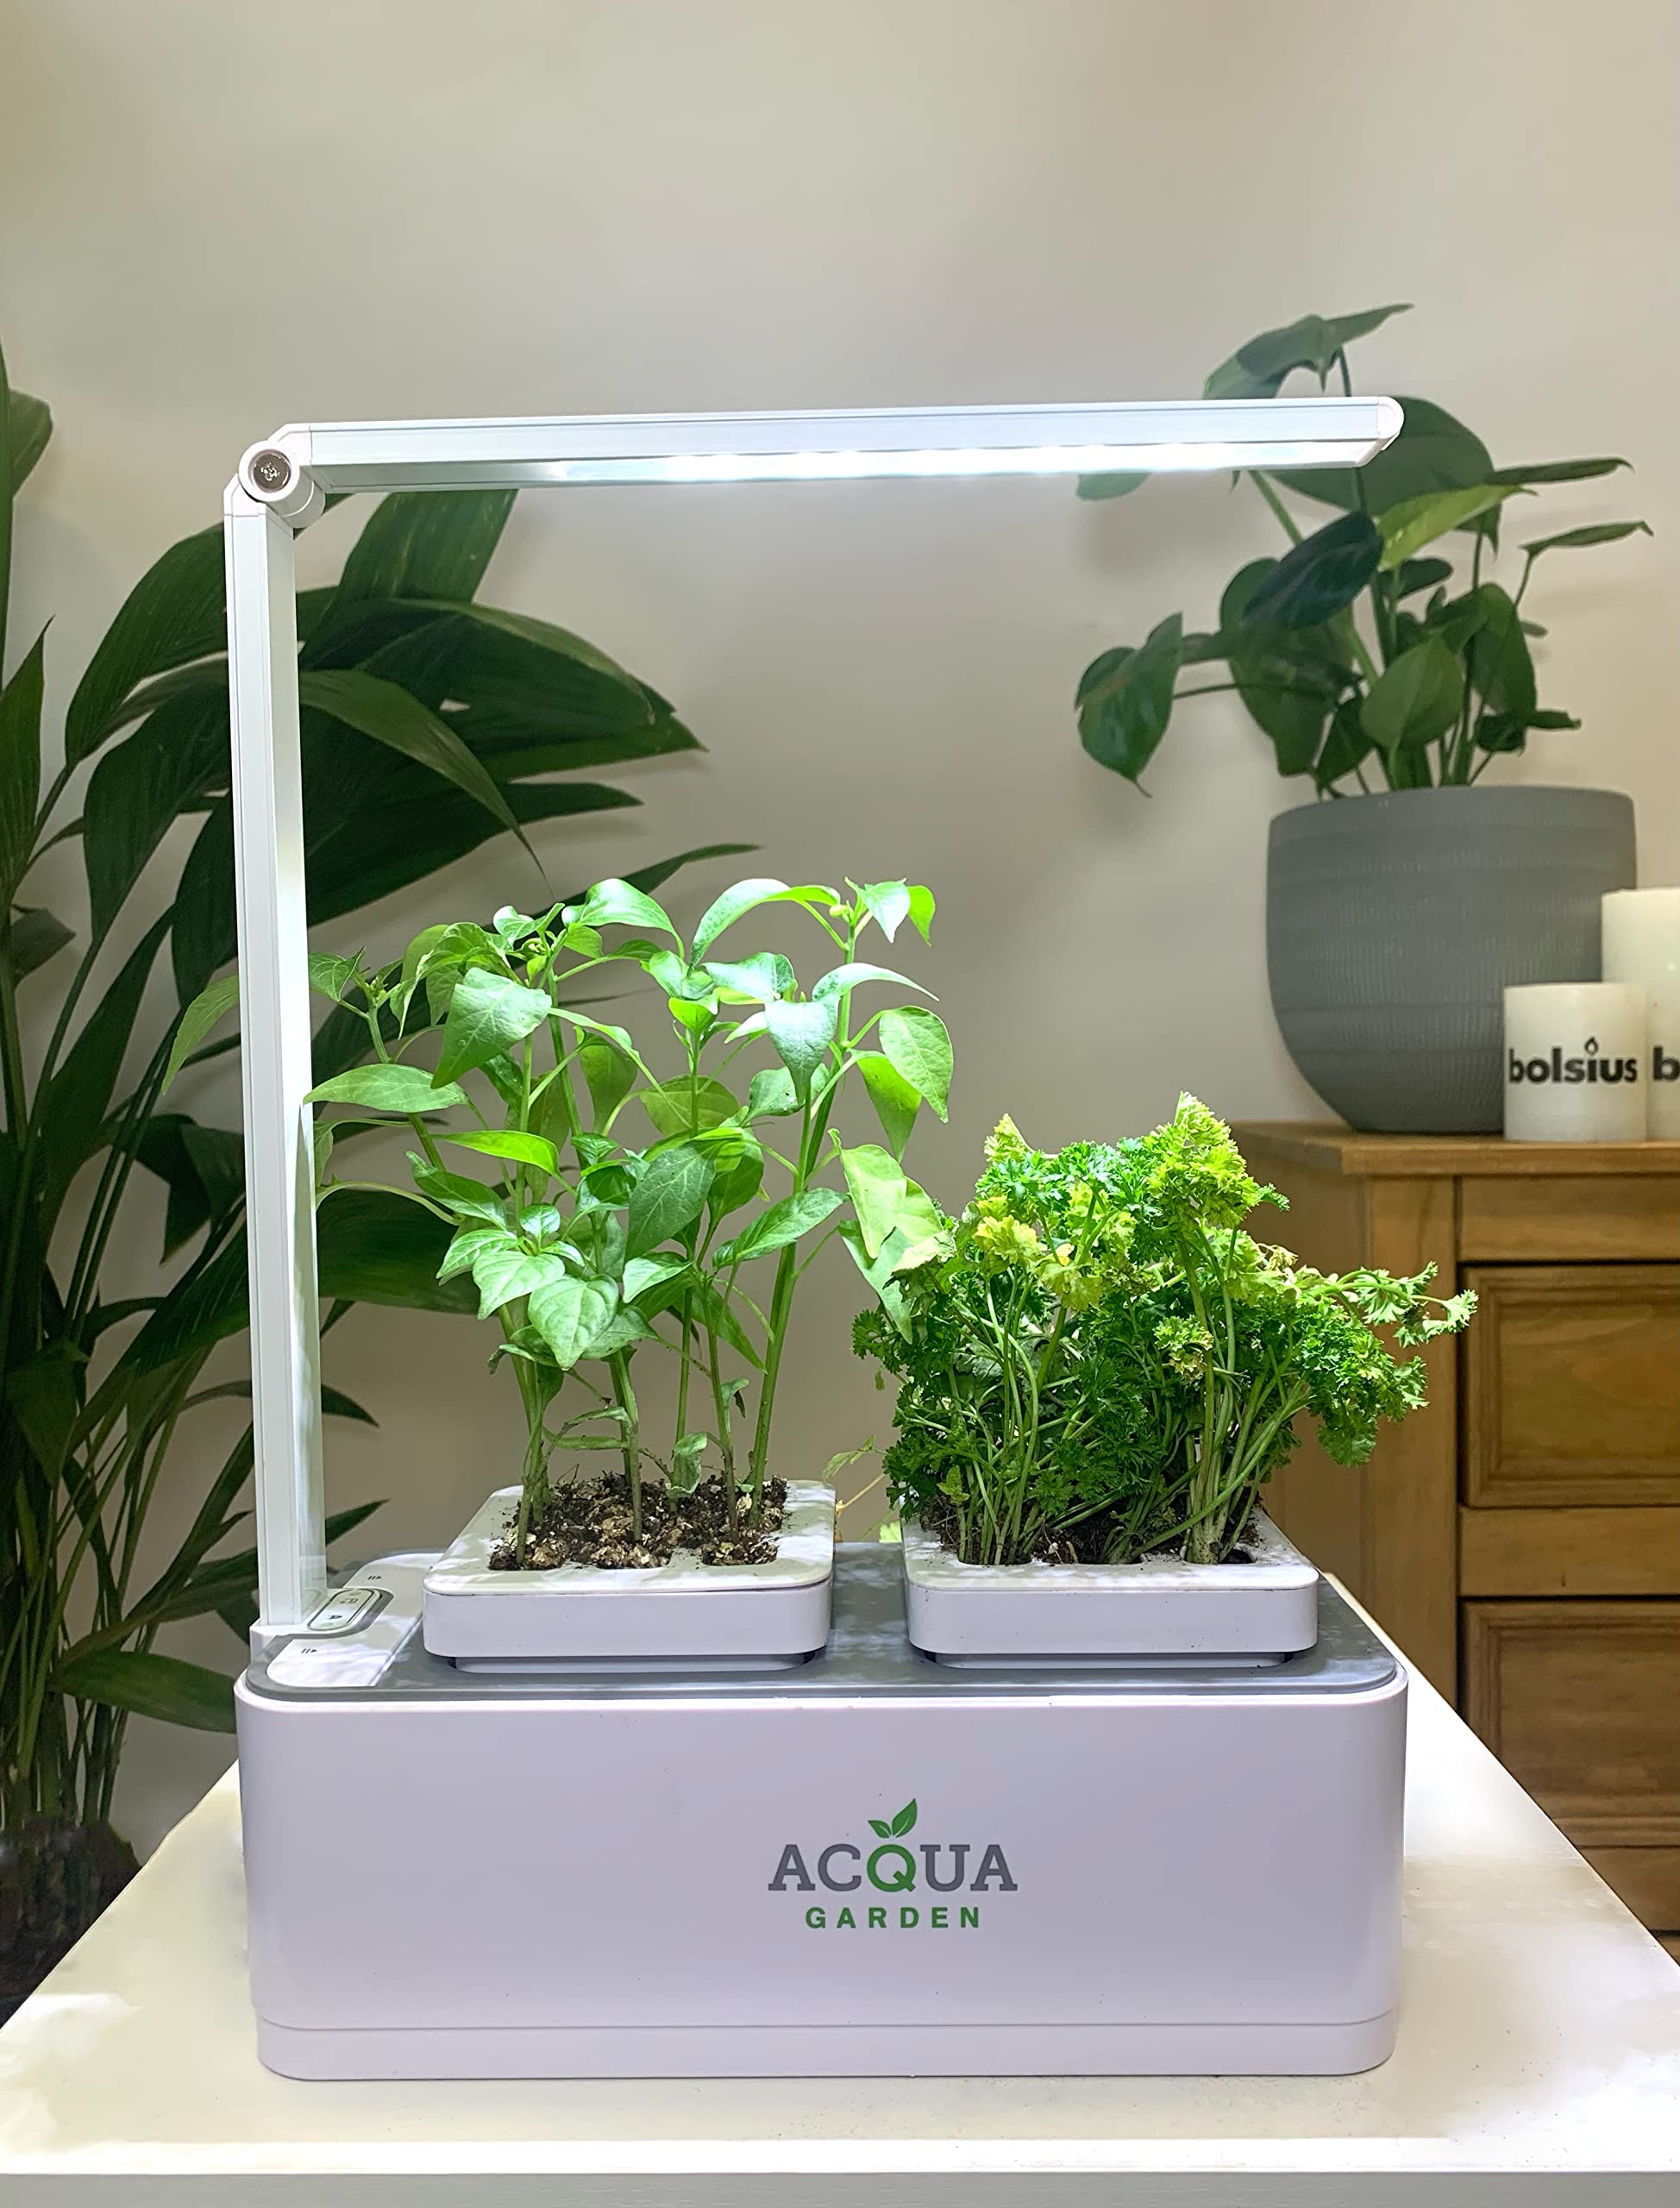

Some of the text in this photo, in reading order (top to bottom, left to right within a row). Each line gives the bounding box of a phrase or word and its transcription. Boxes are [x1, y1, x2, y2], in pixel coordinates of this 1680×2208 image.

[1508, 1037, 1638, 1083] bolsius
[768, 1843, 1018, 1891] ACQUA
[805, 1906, 979, 1929] GARDEN
